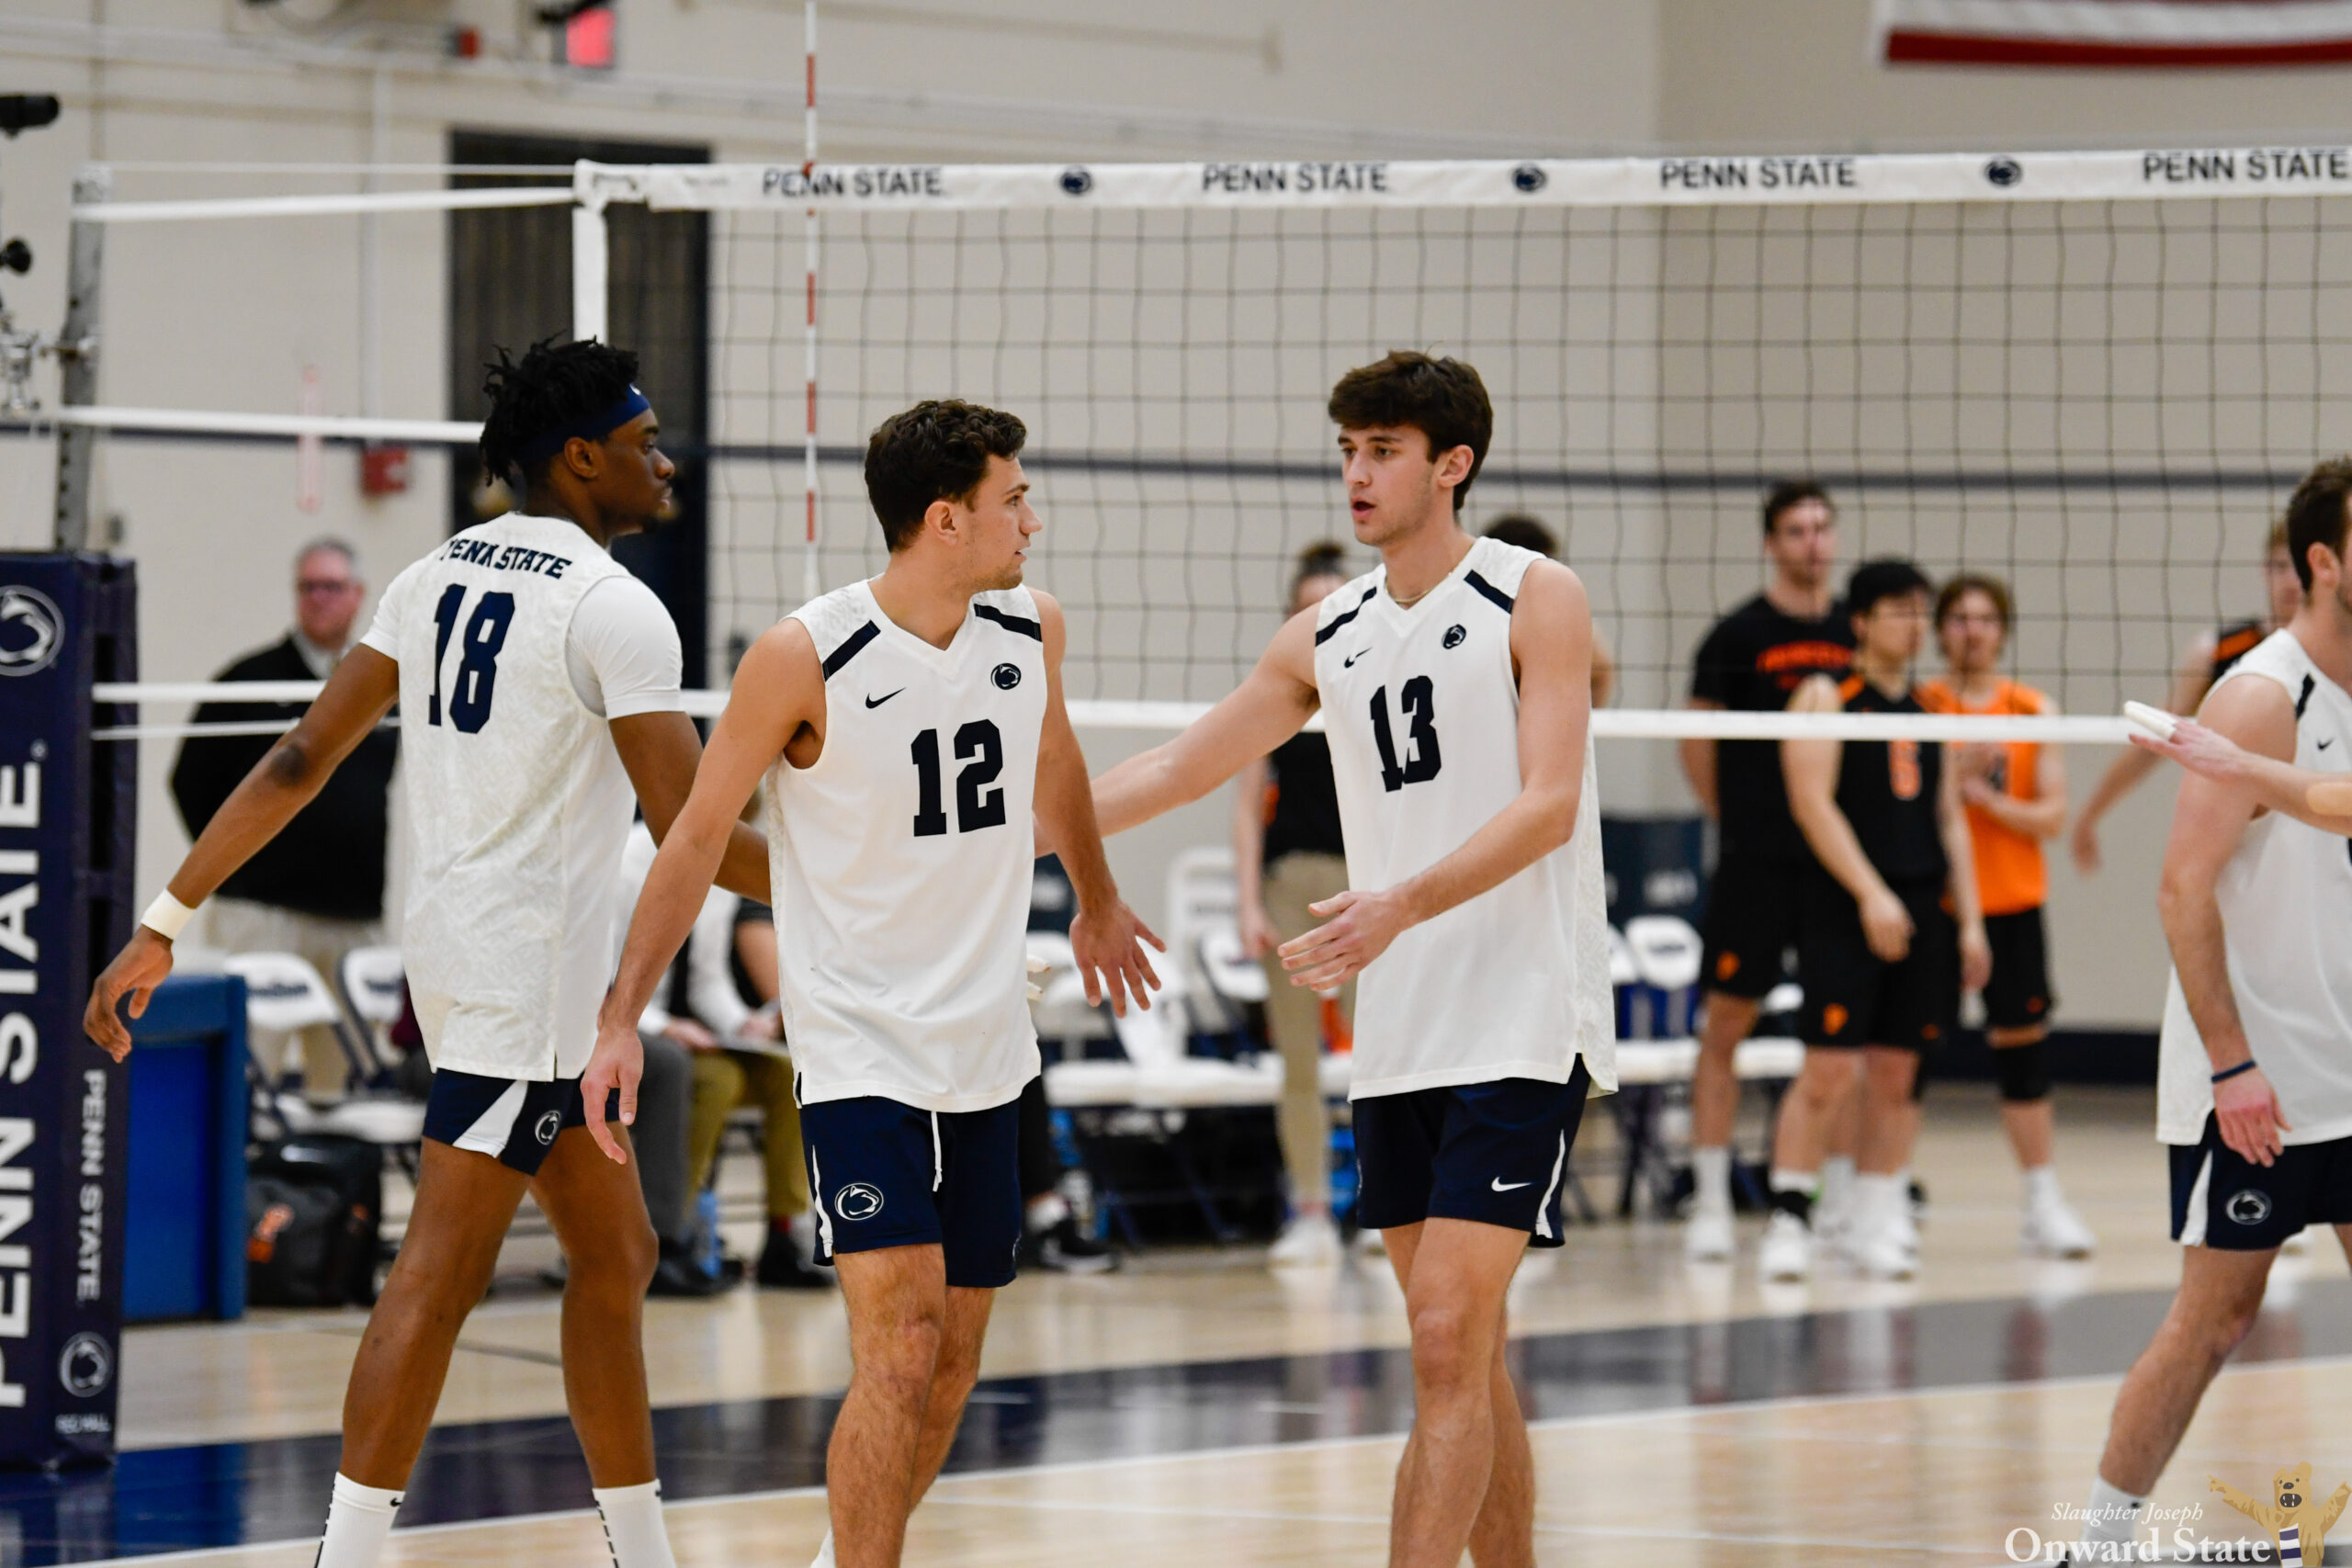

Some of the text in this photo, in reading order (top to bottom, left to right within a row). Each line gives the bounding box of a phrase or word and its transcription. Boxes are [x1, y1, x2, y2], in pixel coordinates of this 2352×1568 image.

[763, 166, 843, 197] PENN
[854, 168, 942, 197] STATE
[1203, 164, 1388, 192] PENN STATE
[1660, 157, 1856, 189] PENN STATE
[2143, 147, 2348, 182] PENN STATE
[493, 547, 572, 580] STATE
[428, 583, 515, 735] 18
[1369, 675, 1442, 793] 13
[910, 718, 1007, 838] 12
[77, 1068, 107, 1302] PENN STATE
